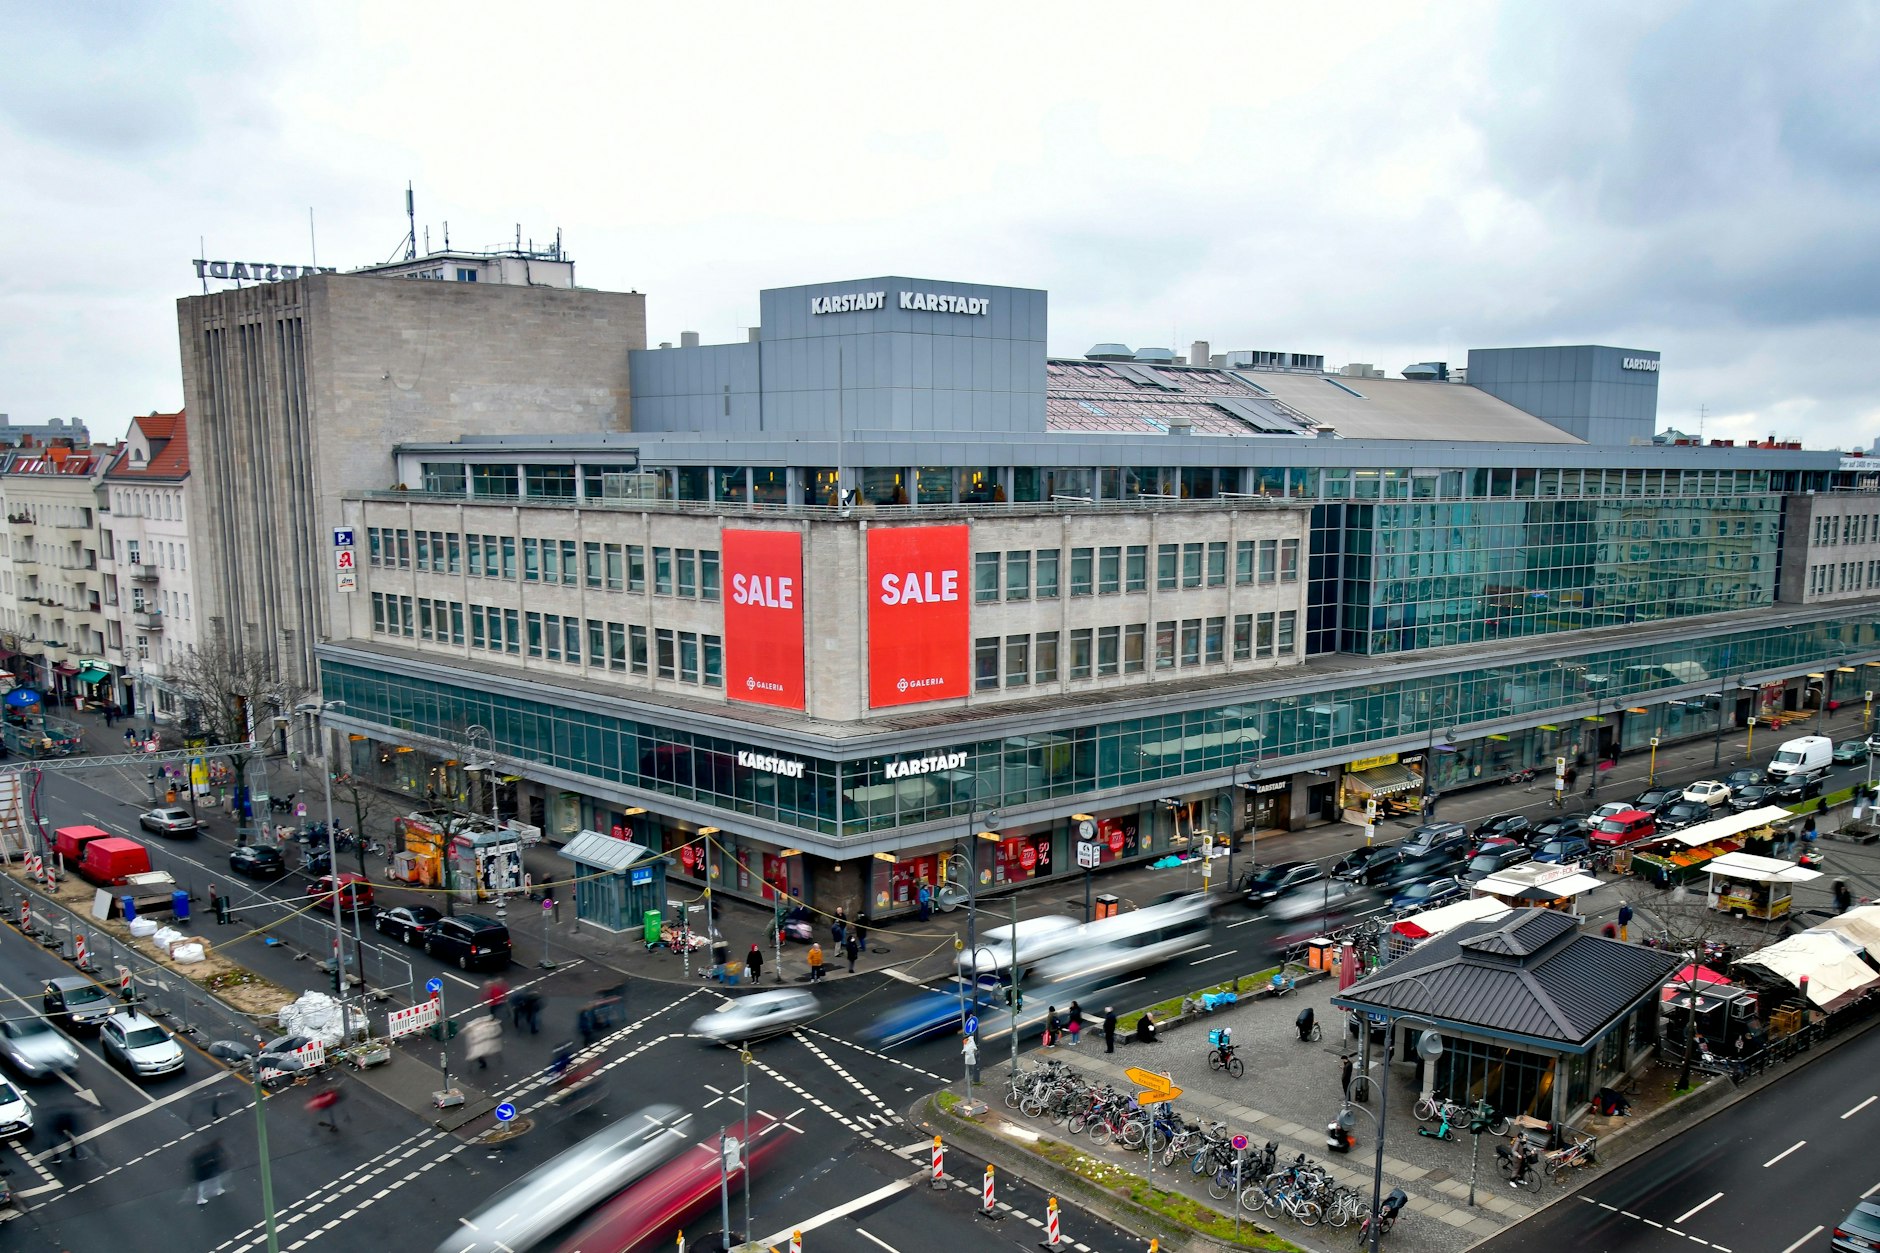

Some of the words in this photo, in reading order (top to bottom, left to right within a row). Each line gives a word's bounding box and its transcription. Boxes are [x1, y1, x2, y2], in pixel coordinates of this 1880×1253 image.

[811, 291, 885, 314] KARSTADT
[900, 291, 989, 315] KARSTADT
[1623, 357, 1660, 371] KARSTADT
[337, 533, 346, 543] P
[339, 551, 352, 567] A
[732, 573, 793, 609] SALE
[881, 569, 958, 605] SALE
[756, 681, 784, 692] GALERIA
[909, 677, 944, 688] GALERIA
[738, 750, 804, 778] KARSTADT
[885, 752, 968, 779] KARSTADT
[1257, 781, 1286, 793] KARSTADT
[695, 847, 704, 857] 50
[1039, 842, 1049, 852] 50
[1039, 852, 1049, 865] %
[633, 871, 639, 879] U
